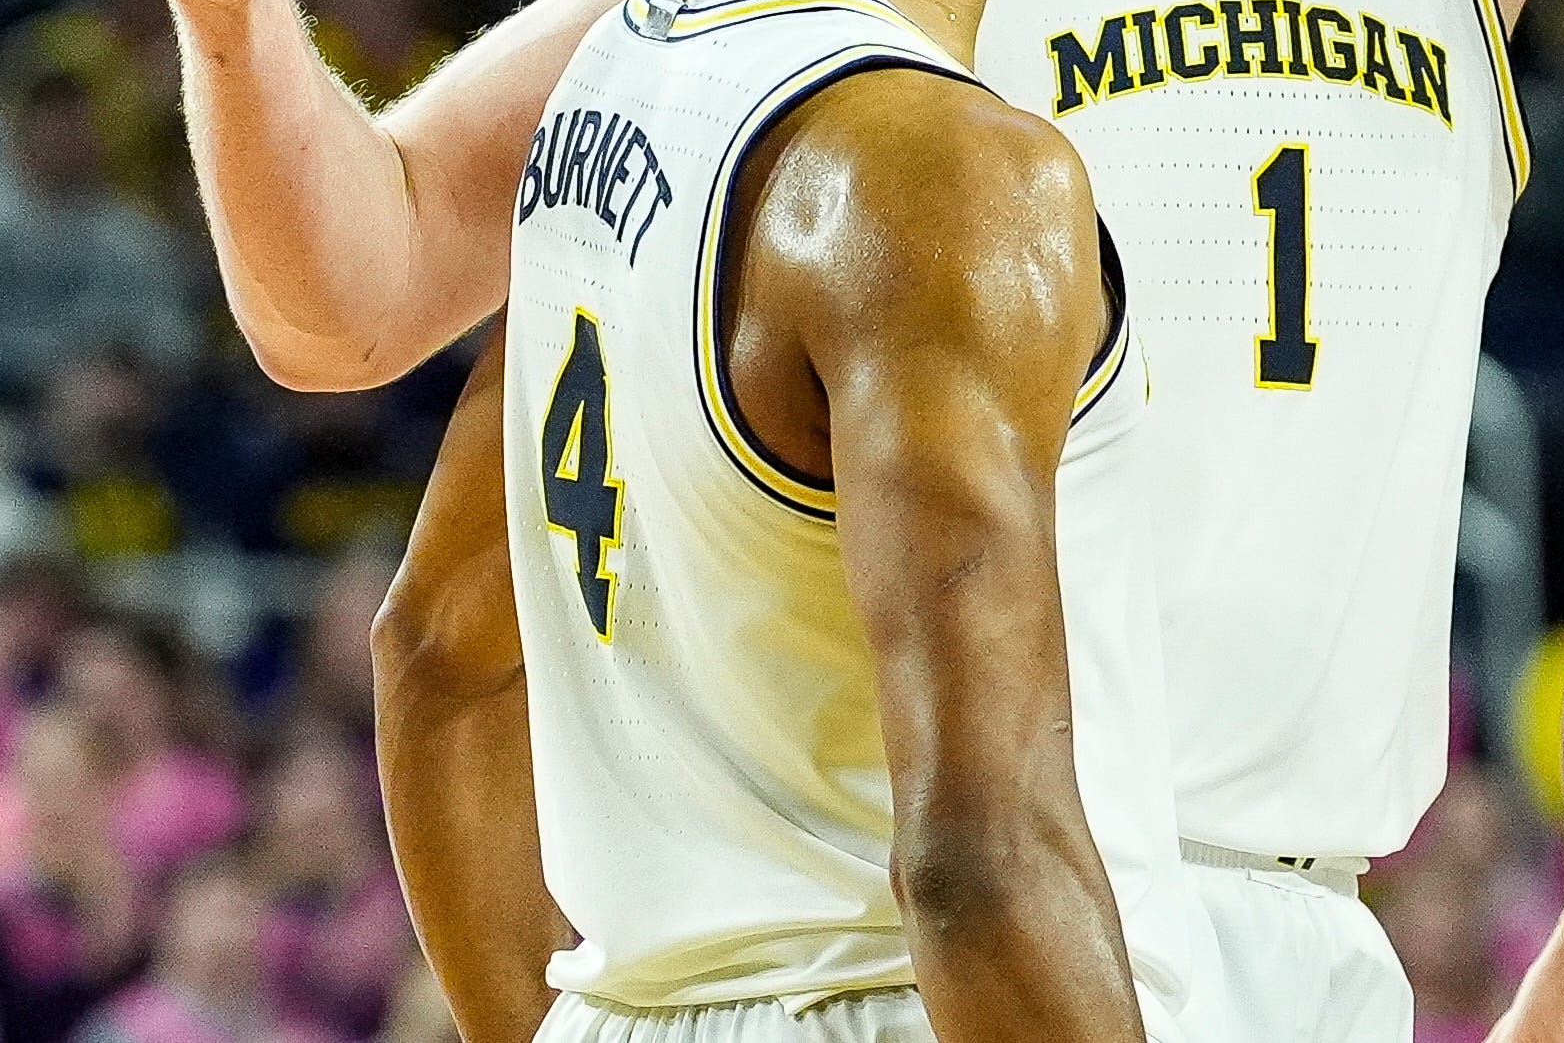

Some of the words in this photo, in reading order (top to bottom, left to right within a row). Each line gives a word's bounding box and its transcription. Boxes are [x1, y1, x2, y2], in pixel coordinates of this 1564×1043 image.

[519, 108, 673, 269] BURNETT
[1250, 143, 1320, 391] 1
[541, 305, 625, 644] 4
